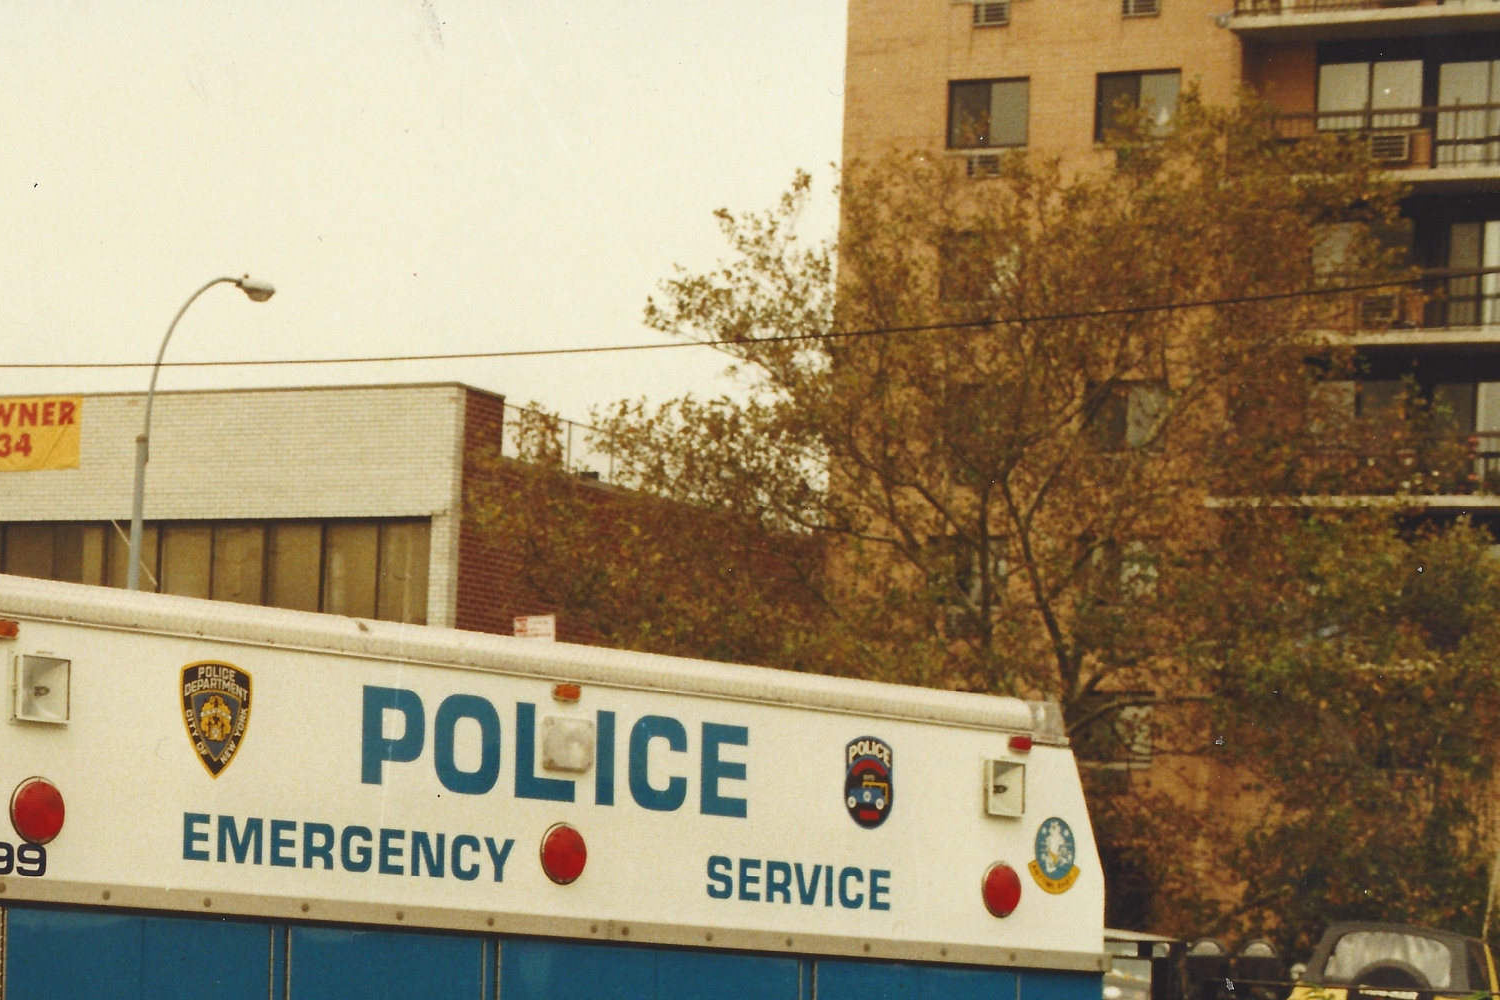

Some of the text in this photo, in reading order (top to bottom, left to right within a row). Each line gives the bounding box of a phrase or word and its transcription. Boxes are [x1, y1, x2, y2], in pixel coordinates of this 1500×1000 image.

[184, 678, 248, 701] DEPARTMENT
[198, 666, 236, 682] POLICE
[185, 709, 208, 756] CITY OF
[220, 707, 249, 765] NEW YORK
[361, 684, 749, 819] POLICE
[848, 740, 891, 769] POLICE
[182, 811, 516, 884] EMERGENCY
[706, 855, 892, 911] SERVICE
